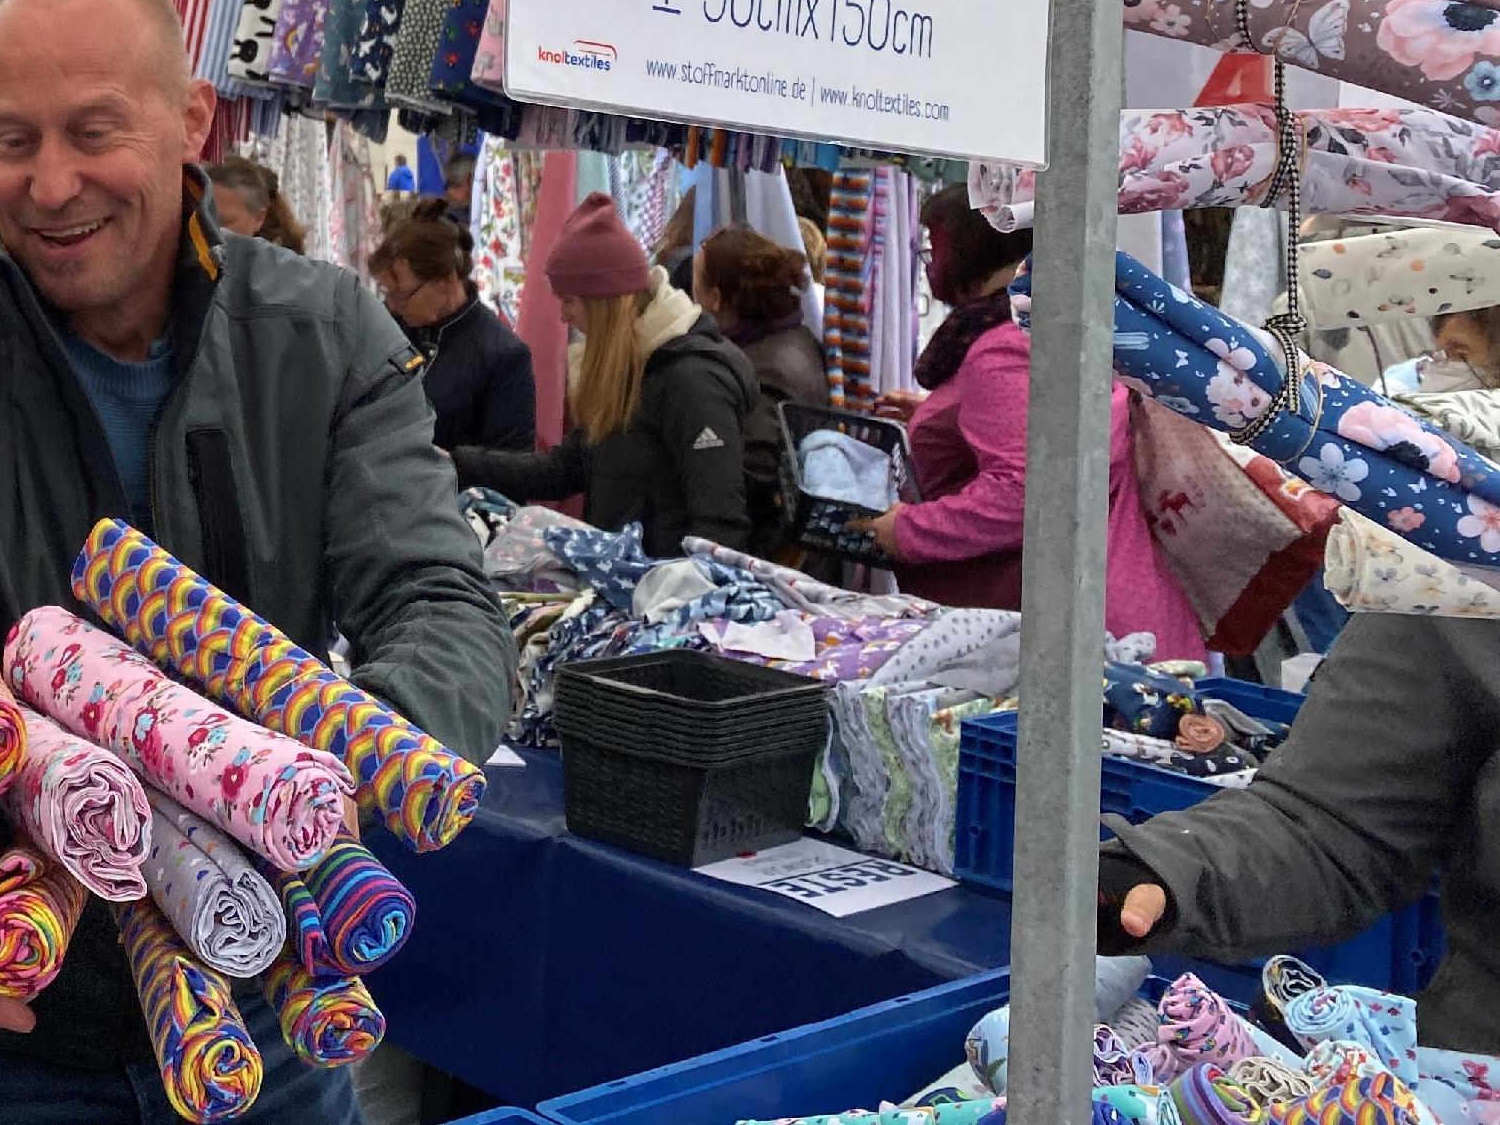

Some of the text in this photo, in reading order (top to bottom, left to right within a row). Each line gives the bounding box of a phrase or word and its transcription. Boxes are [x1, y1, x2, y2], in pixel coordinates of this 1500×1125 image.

[537, 45, 612, 72] knoltextiles
[645, 58, 807, 101] www.stoffmarktonline.de
[819, 85, 951, 122] www.knoltextiles.com
